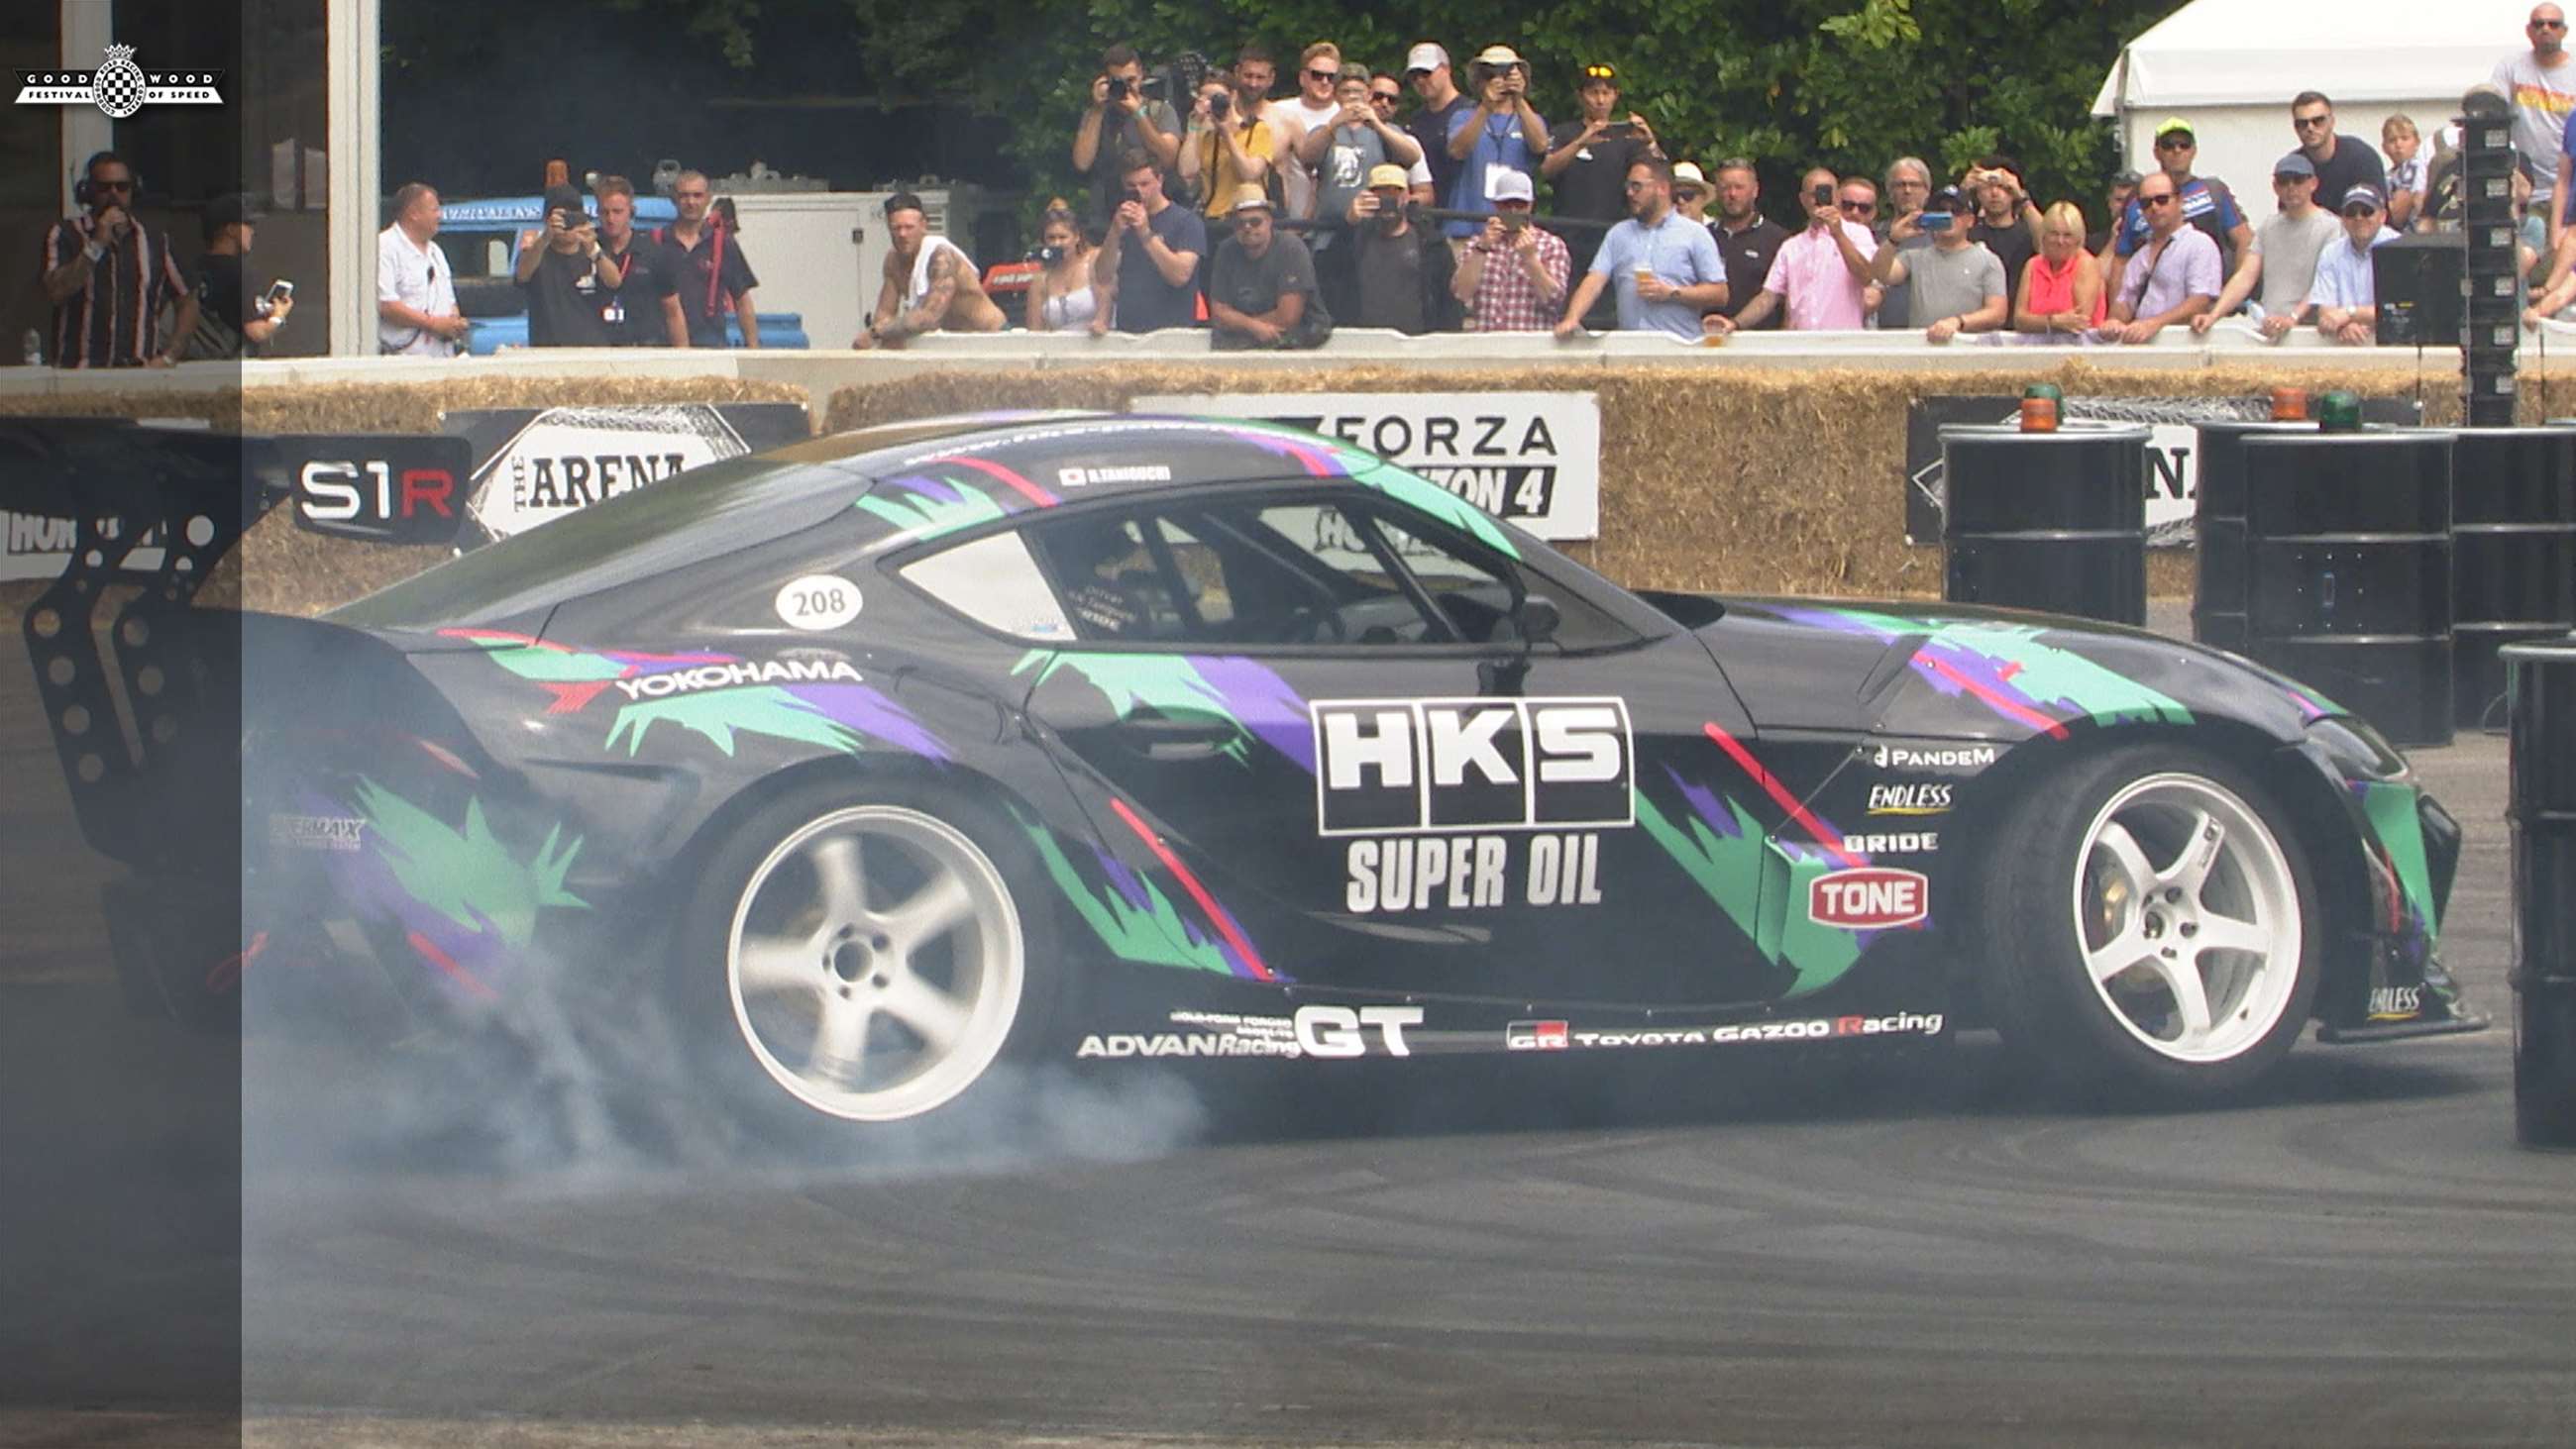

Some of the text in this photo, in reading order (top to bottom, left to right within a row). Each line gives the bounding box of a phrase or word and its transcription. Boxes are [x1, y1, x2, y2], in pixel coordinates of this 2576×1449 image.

[1336, 415, 1557, 457] FORZA
[1514, 467, 1546, 514] 4
[794, 587, 847, 616] 208
[615, 661, 864, 700] YOKOHAMA
[1325, 707, 1622, 789] HKS
[1891, 748, 1995, 767] PANDEM
[1868, 783, 1953, 809] ENDLESS
[1346, 833, 1602, 912] SUPER OIL
[1820, 880, 1916, 915] TONE
[1295, 1005, 1424, 1057] GT
[1510, 1011, 1944, 1049] GR TOYOTA GAZOO Racing
